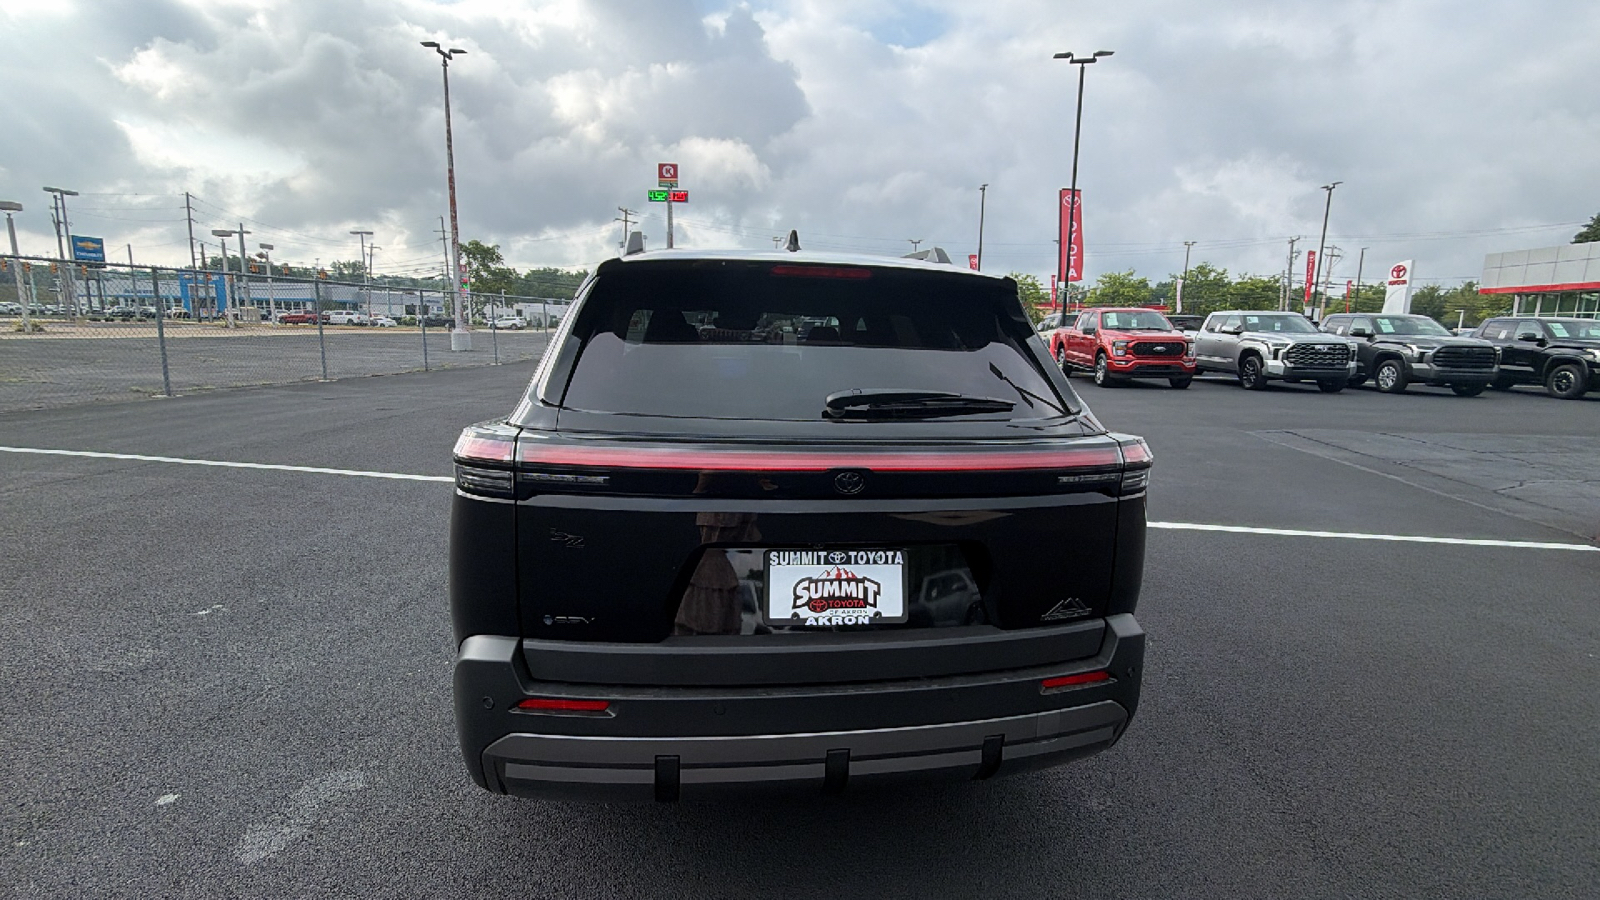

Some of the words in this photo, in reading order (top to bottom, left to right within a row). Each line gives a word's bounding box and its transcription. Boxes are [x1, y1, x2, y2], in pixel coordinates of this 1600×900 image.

[769, 551, 827, 565] SUMMIT
[848, 551, 904, 565] TOYOTA
[795, 580, 878, 606] SUMMIT
[828, 600, 865, 608] TOYOTA
[805, 615, 869, 626] AKRON
